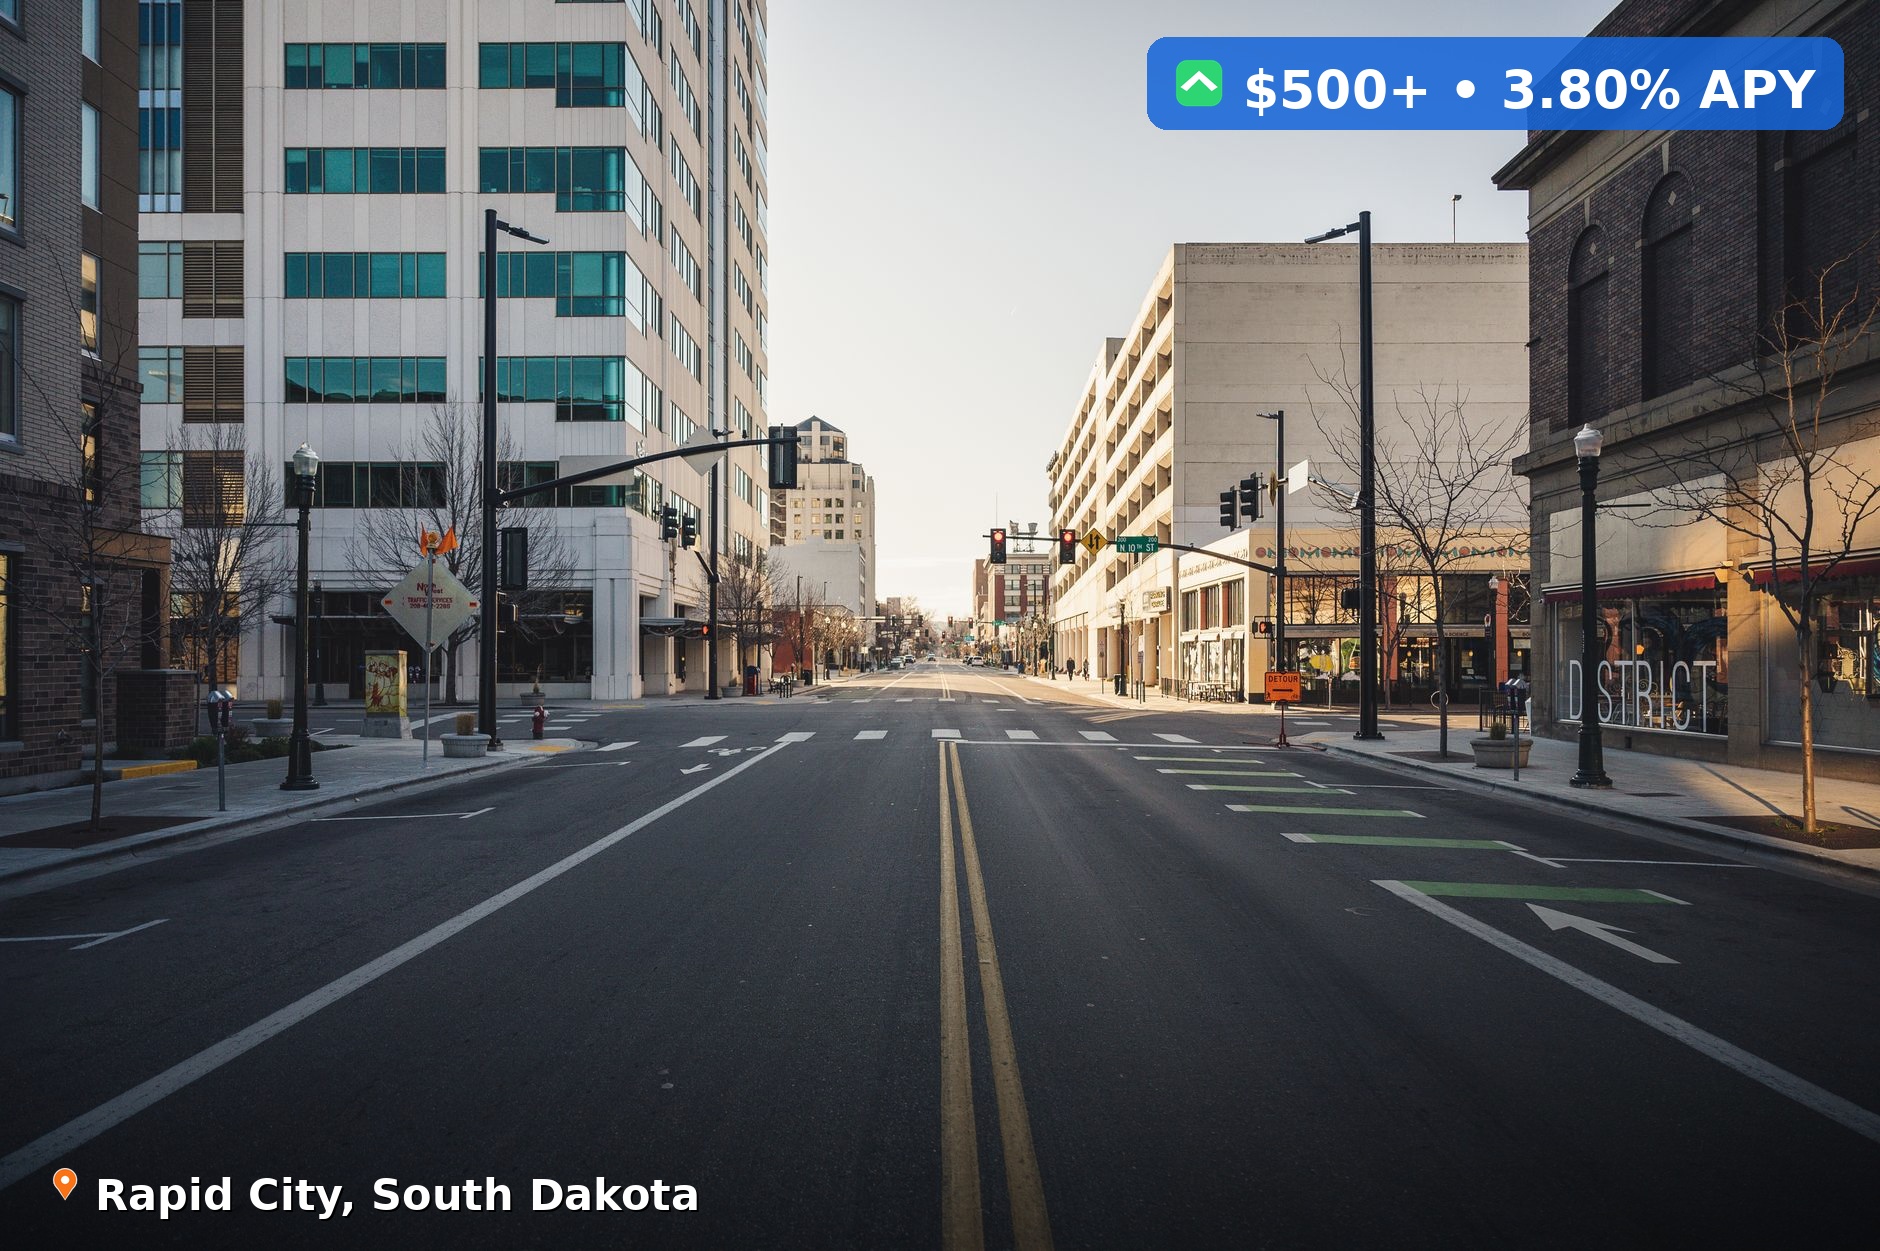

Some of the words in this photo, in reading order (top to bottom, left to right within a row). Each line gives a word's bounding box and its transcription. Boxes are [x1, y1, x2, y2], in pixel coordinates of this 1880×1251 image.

[1119, 544, 1125, 552] N
[1145, 543, 1155, 552] ST
[1268, 675, 1298, 683] DETOUR
[1569, 659, 1717, 733] DSTRICT
